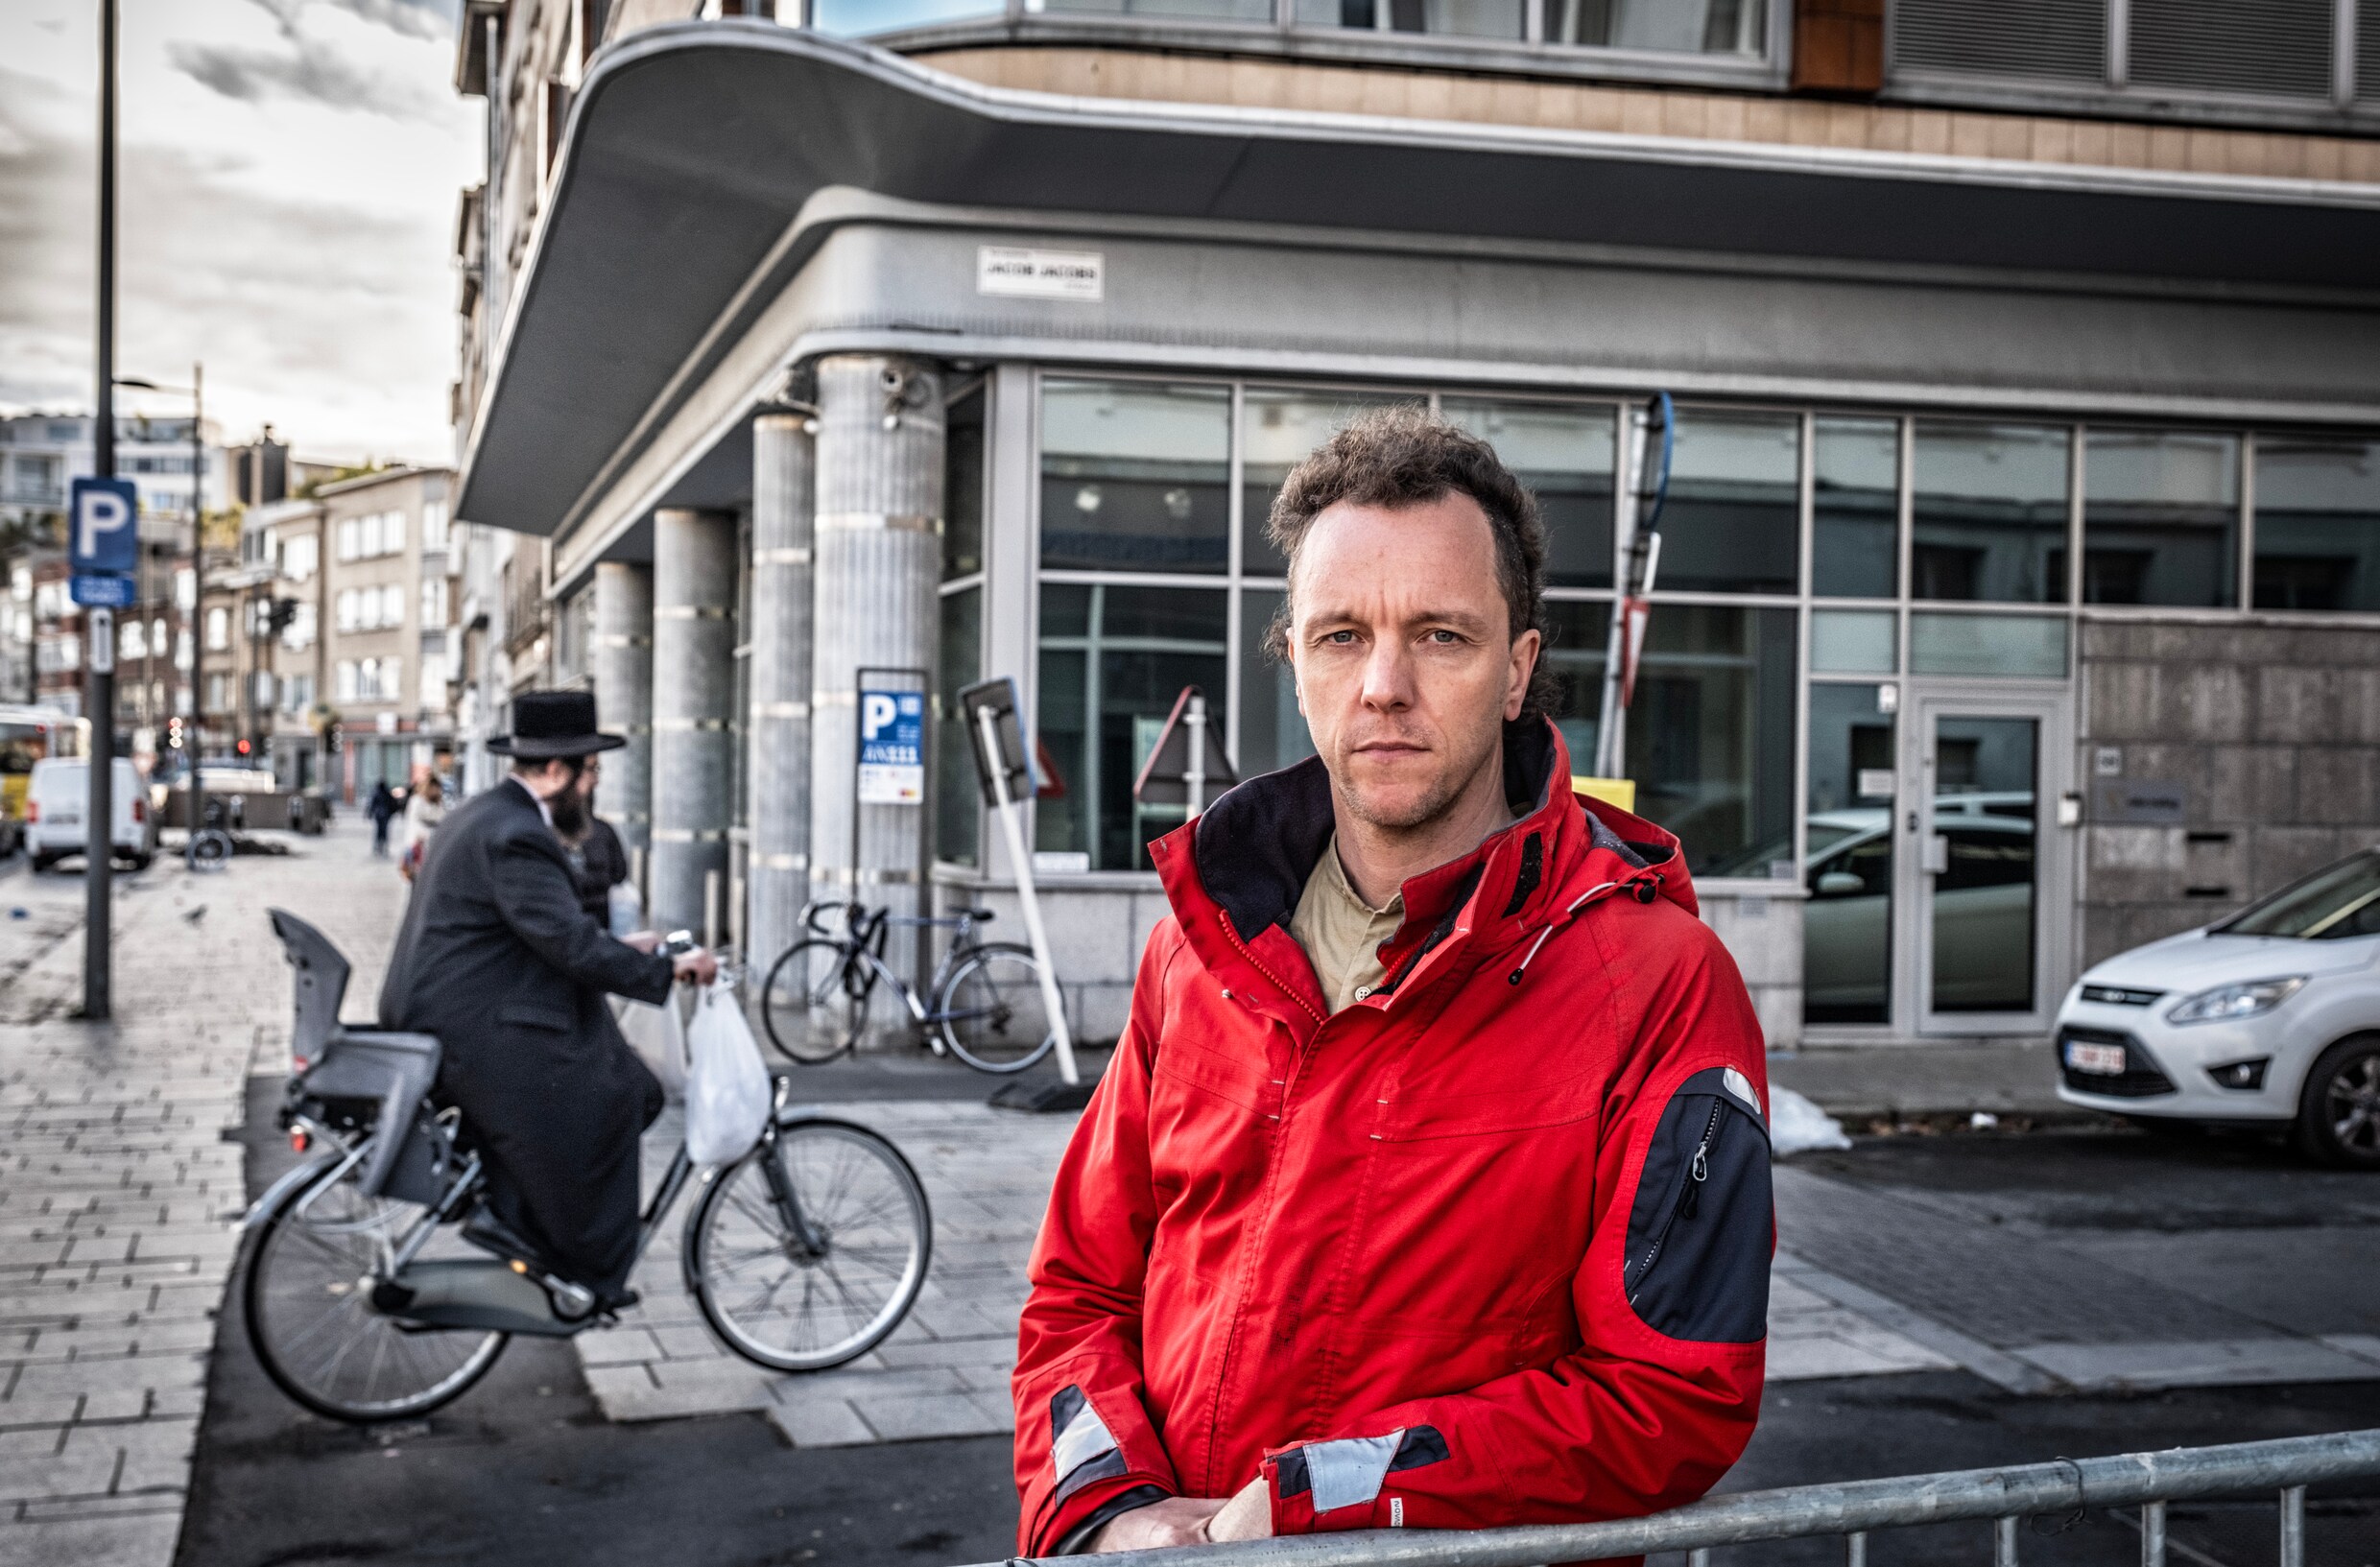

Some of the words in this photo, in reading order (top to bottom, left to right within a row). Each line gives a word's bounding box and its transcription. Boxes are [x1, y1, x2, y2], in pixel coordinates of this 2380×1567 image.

[987, 262, 1035, 275] JACOB
[80, 490, 129, 557] P
[864, 694, 897, 739] P
